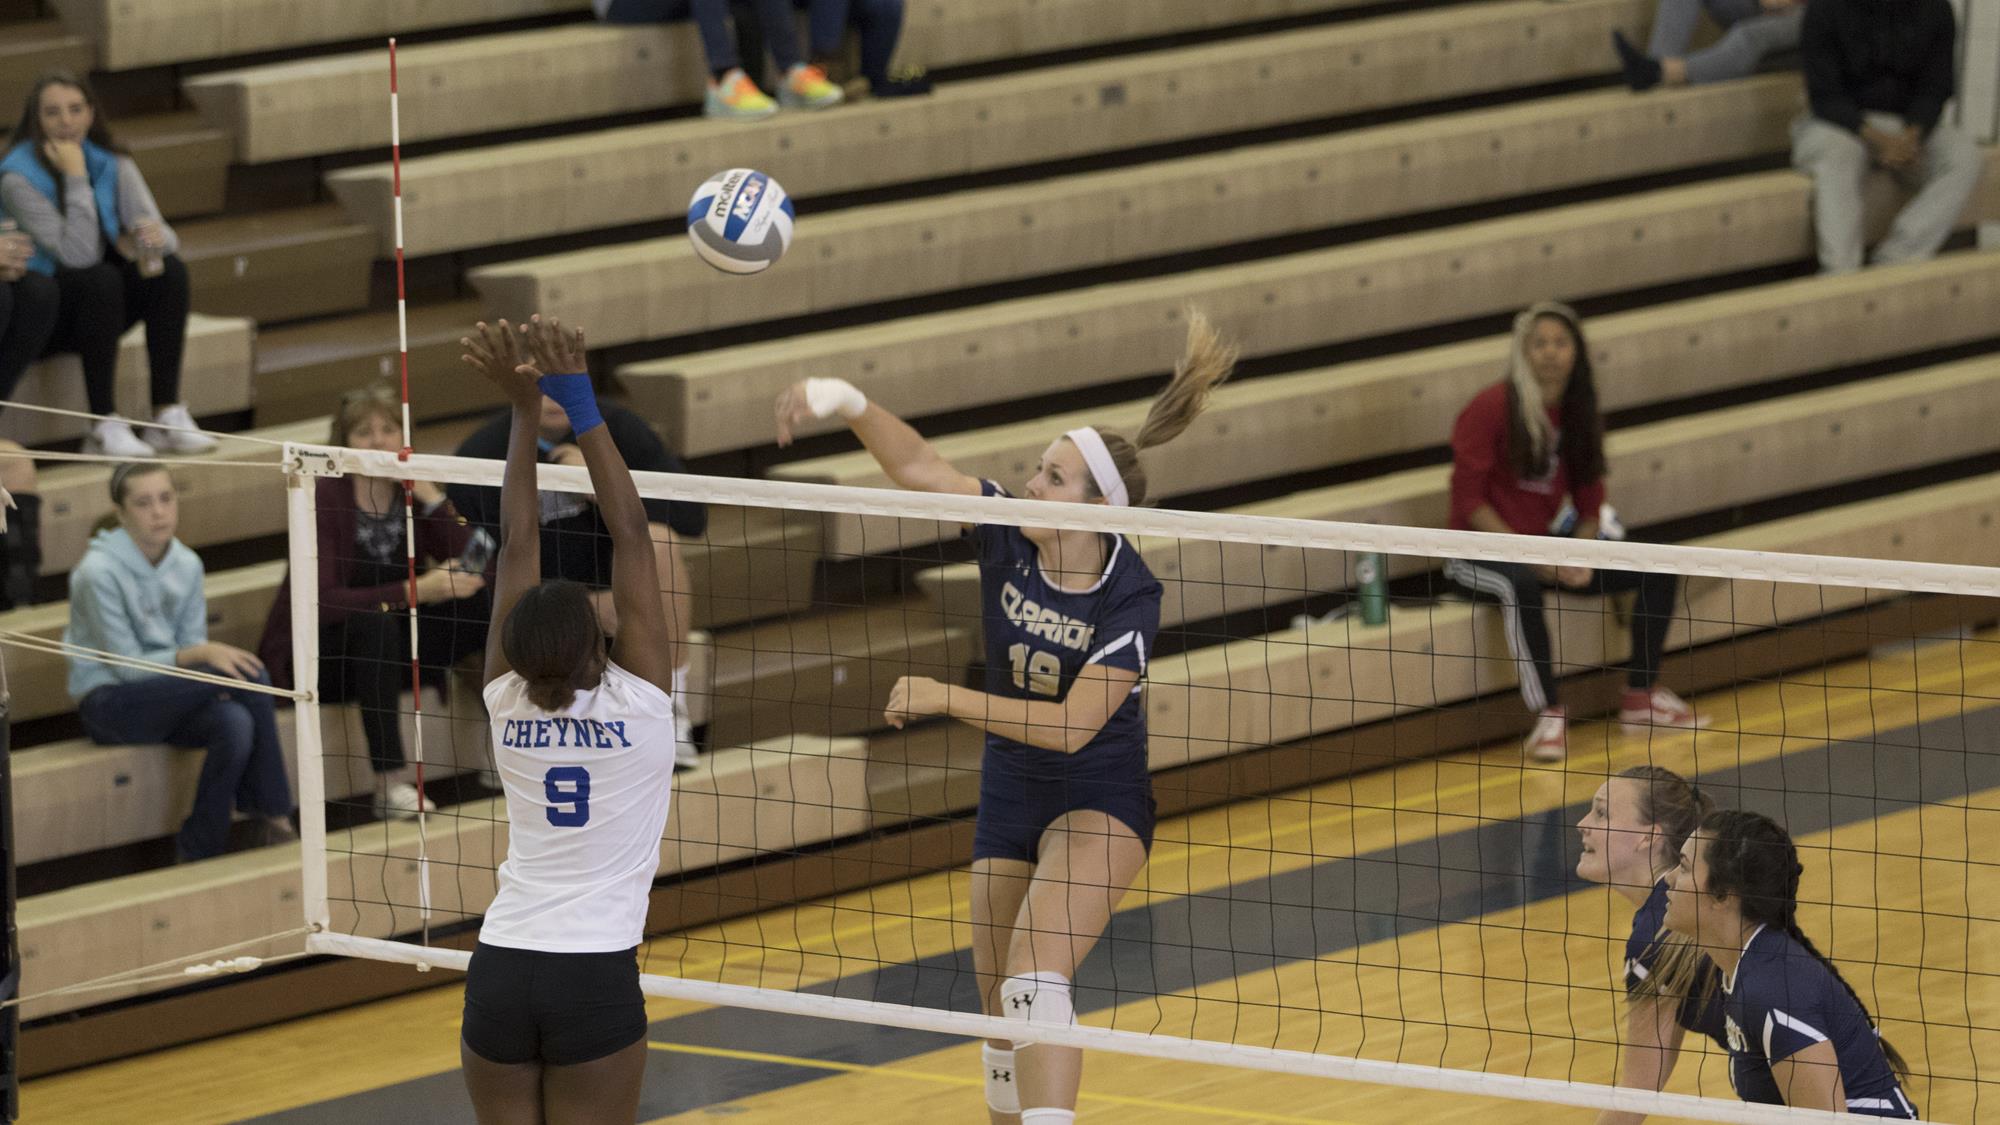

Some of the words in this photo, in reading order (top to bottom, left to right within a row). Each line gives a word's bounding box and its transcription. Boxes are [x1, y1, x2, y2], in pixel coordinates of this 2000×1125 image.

[1009, 642, 1061, 696] 19
[502, 717, 632, 748] CHEYNEY
[544, 766, 590, 827] 9
